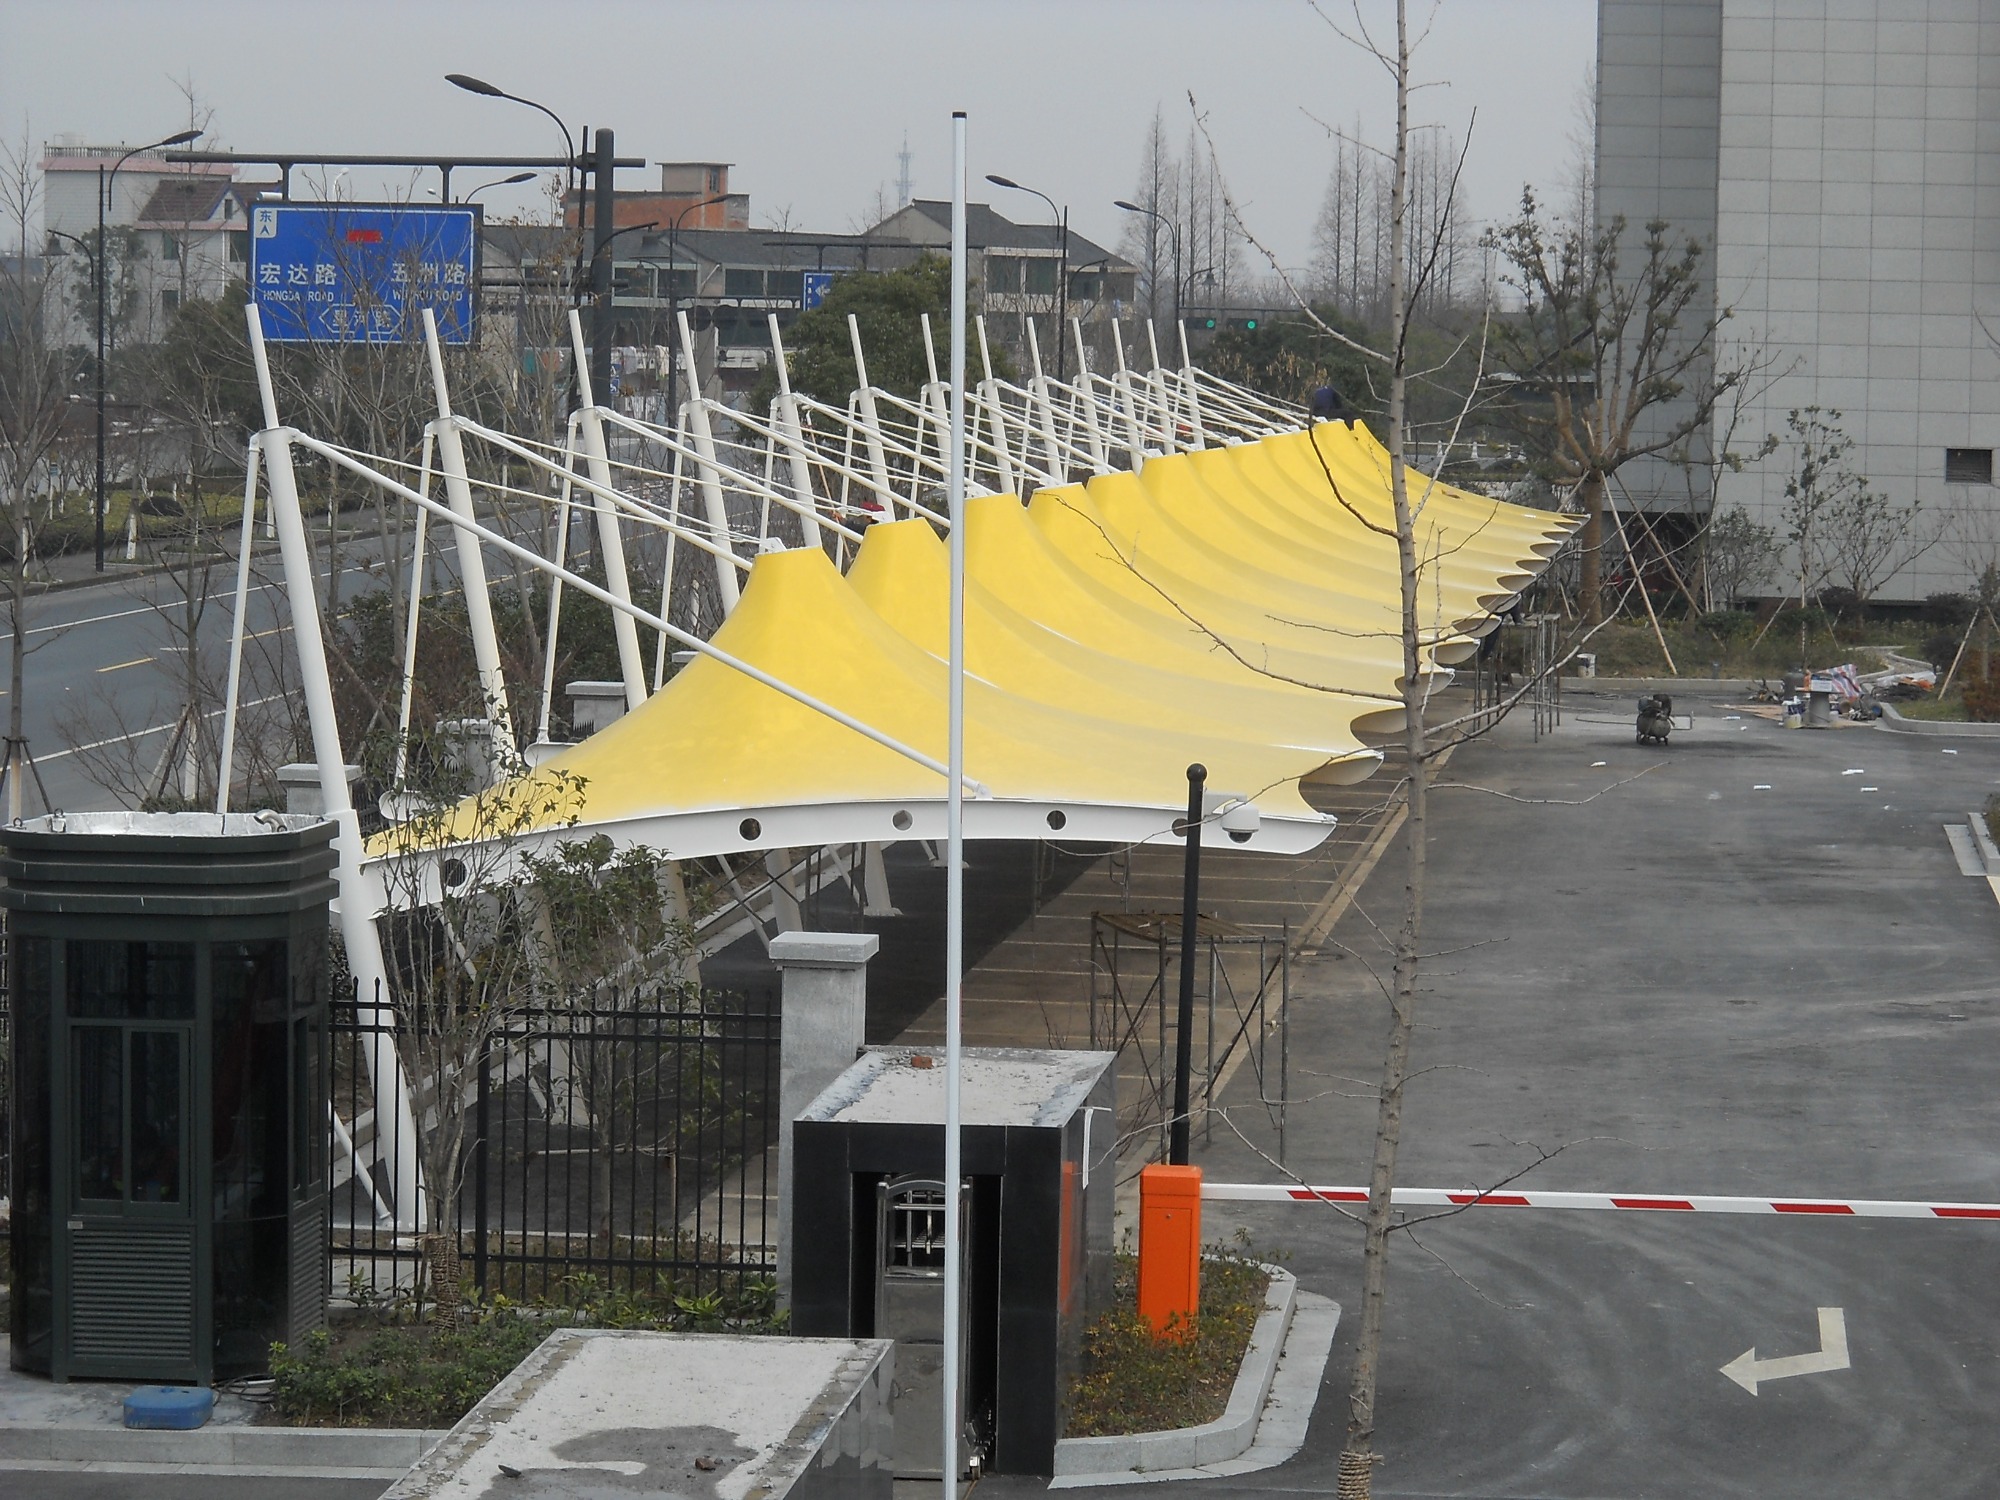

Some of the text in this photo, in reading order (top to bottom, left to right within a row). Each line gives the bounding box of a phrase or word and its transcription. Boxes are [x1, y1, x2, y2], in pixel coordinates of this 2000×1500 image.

[260, 209, 272, 223] 东
[260, 262, 337, 286] 宏达路
[263, 290, 335, 302] HONGDA ROAD
